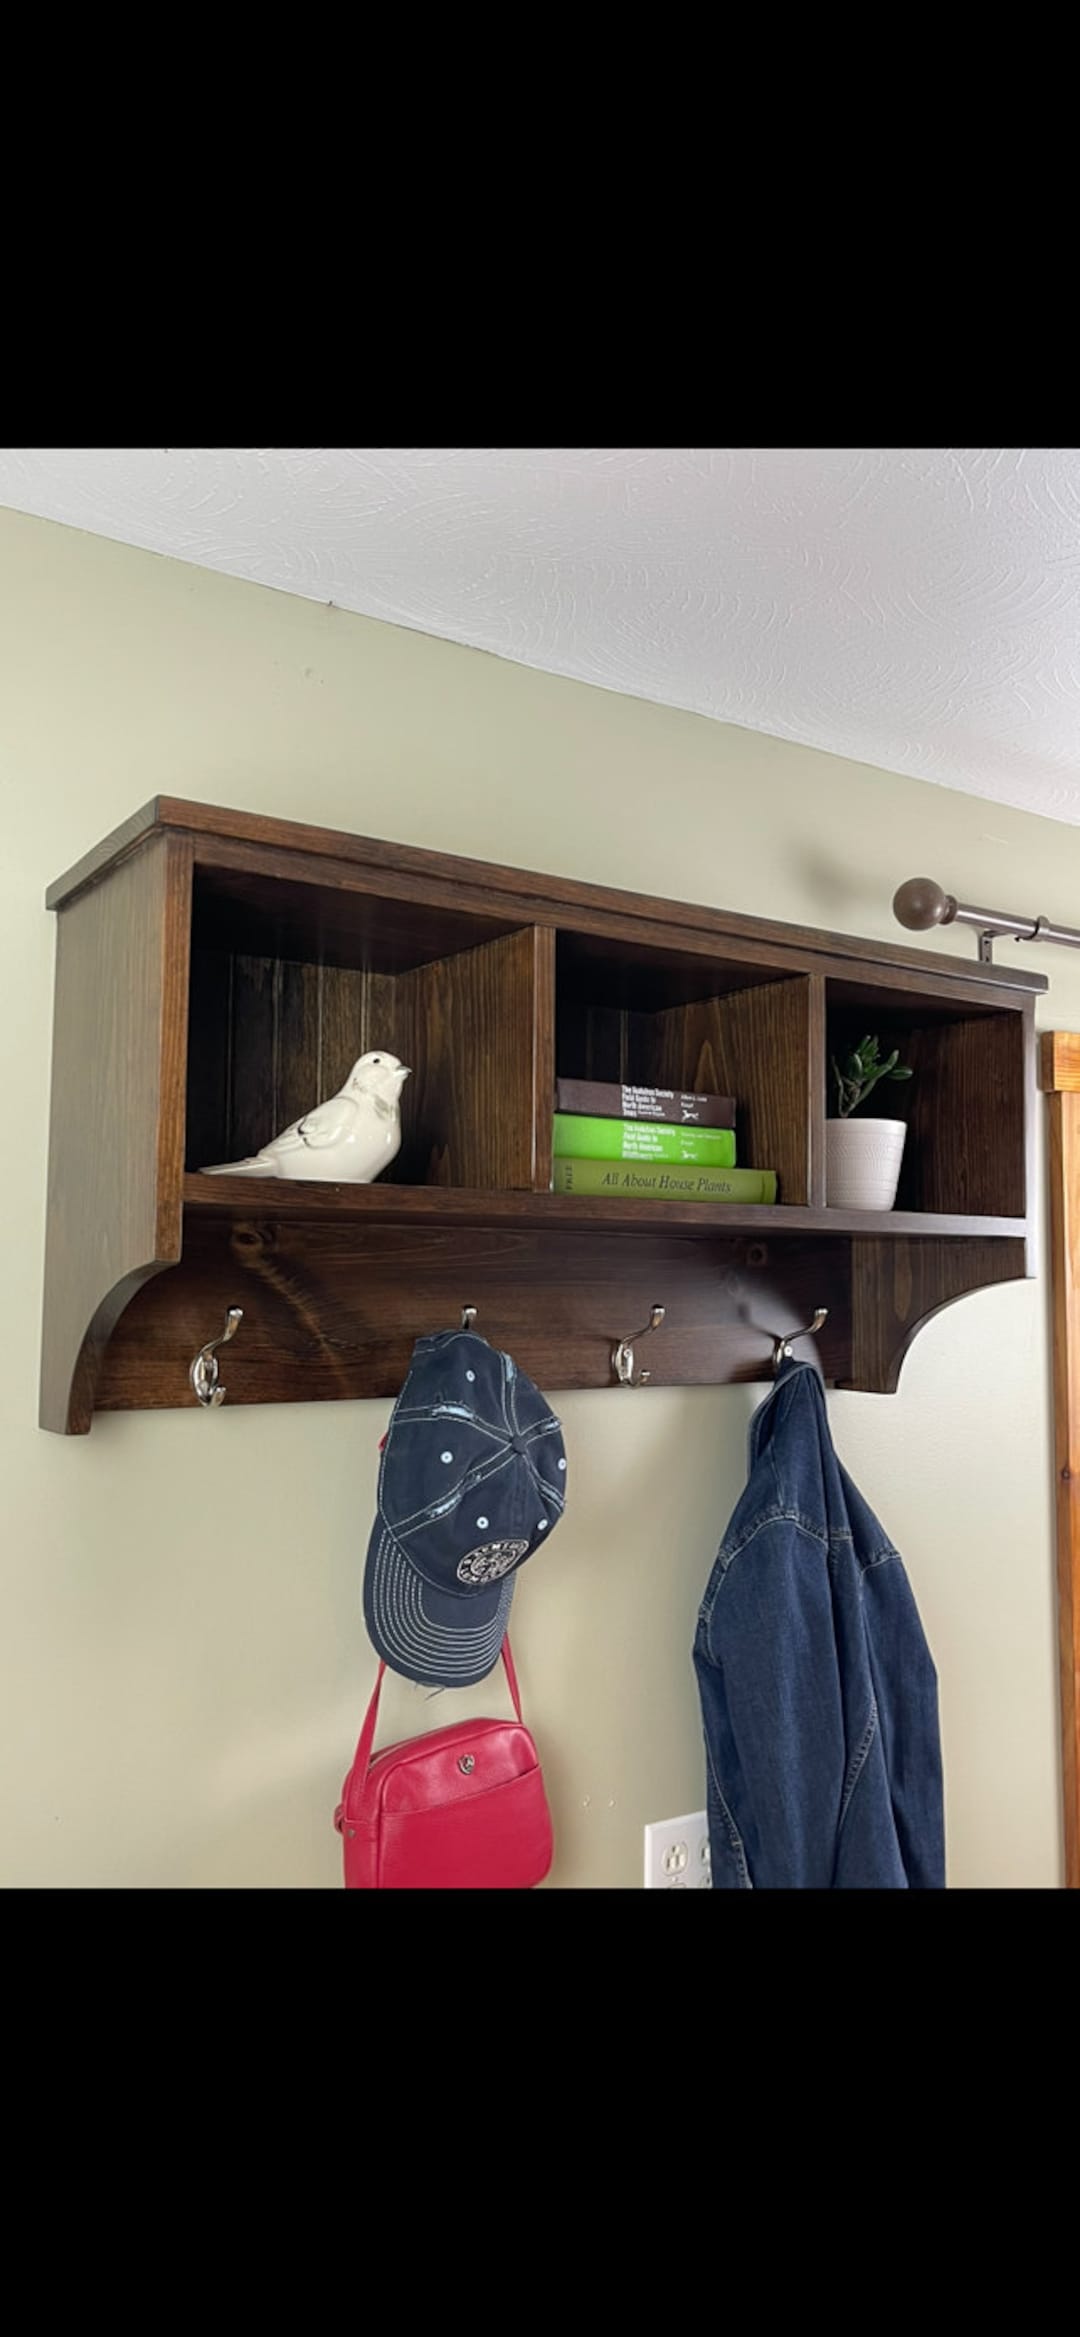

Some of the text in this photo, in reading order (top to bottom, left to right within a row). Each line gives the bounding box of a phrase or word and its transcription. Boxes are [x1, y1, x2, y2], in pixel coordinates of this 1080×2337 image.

[602, 1172, 731, 1193] All About House Plants
